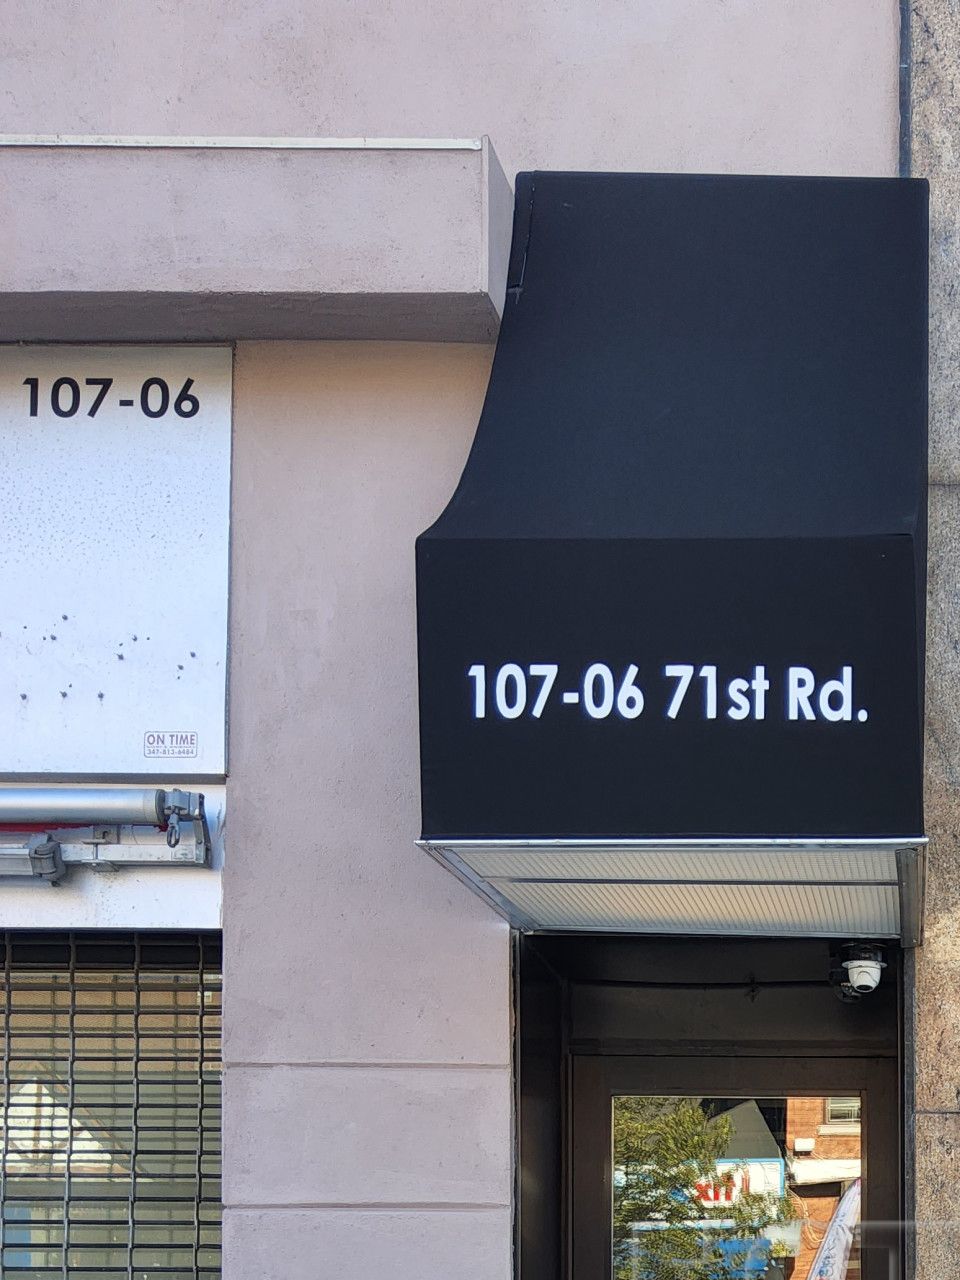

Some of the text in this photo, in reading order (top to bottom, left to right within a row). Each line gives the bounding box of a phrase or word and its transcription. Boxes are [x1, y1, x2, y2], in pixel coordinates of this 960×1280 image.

[22, 376, 201, 419] 107-06
[468, 663, 868, 722] 107-06 71st Rd.
[147, 734, 196, 745] ON TIME
